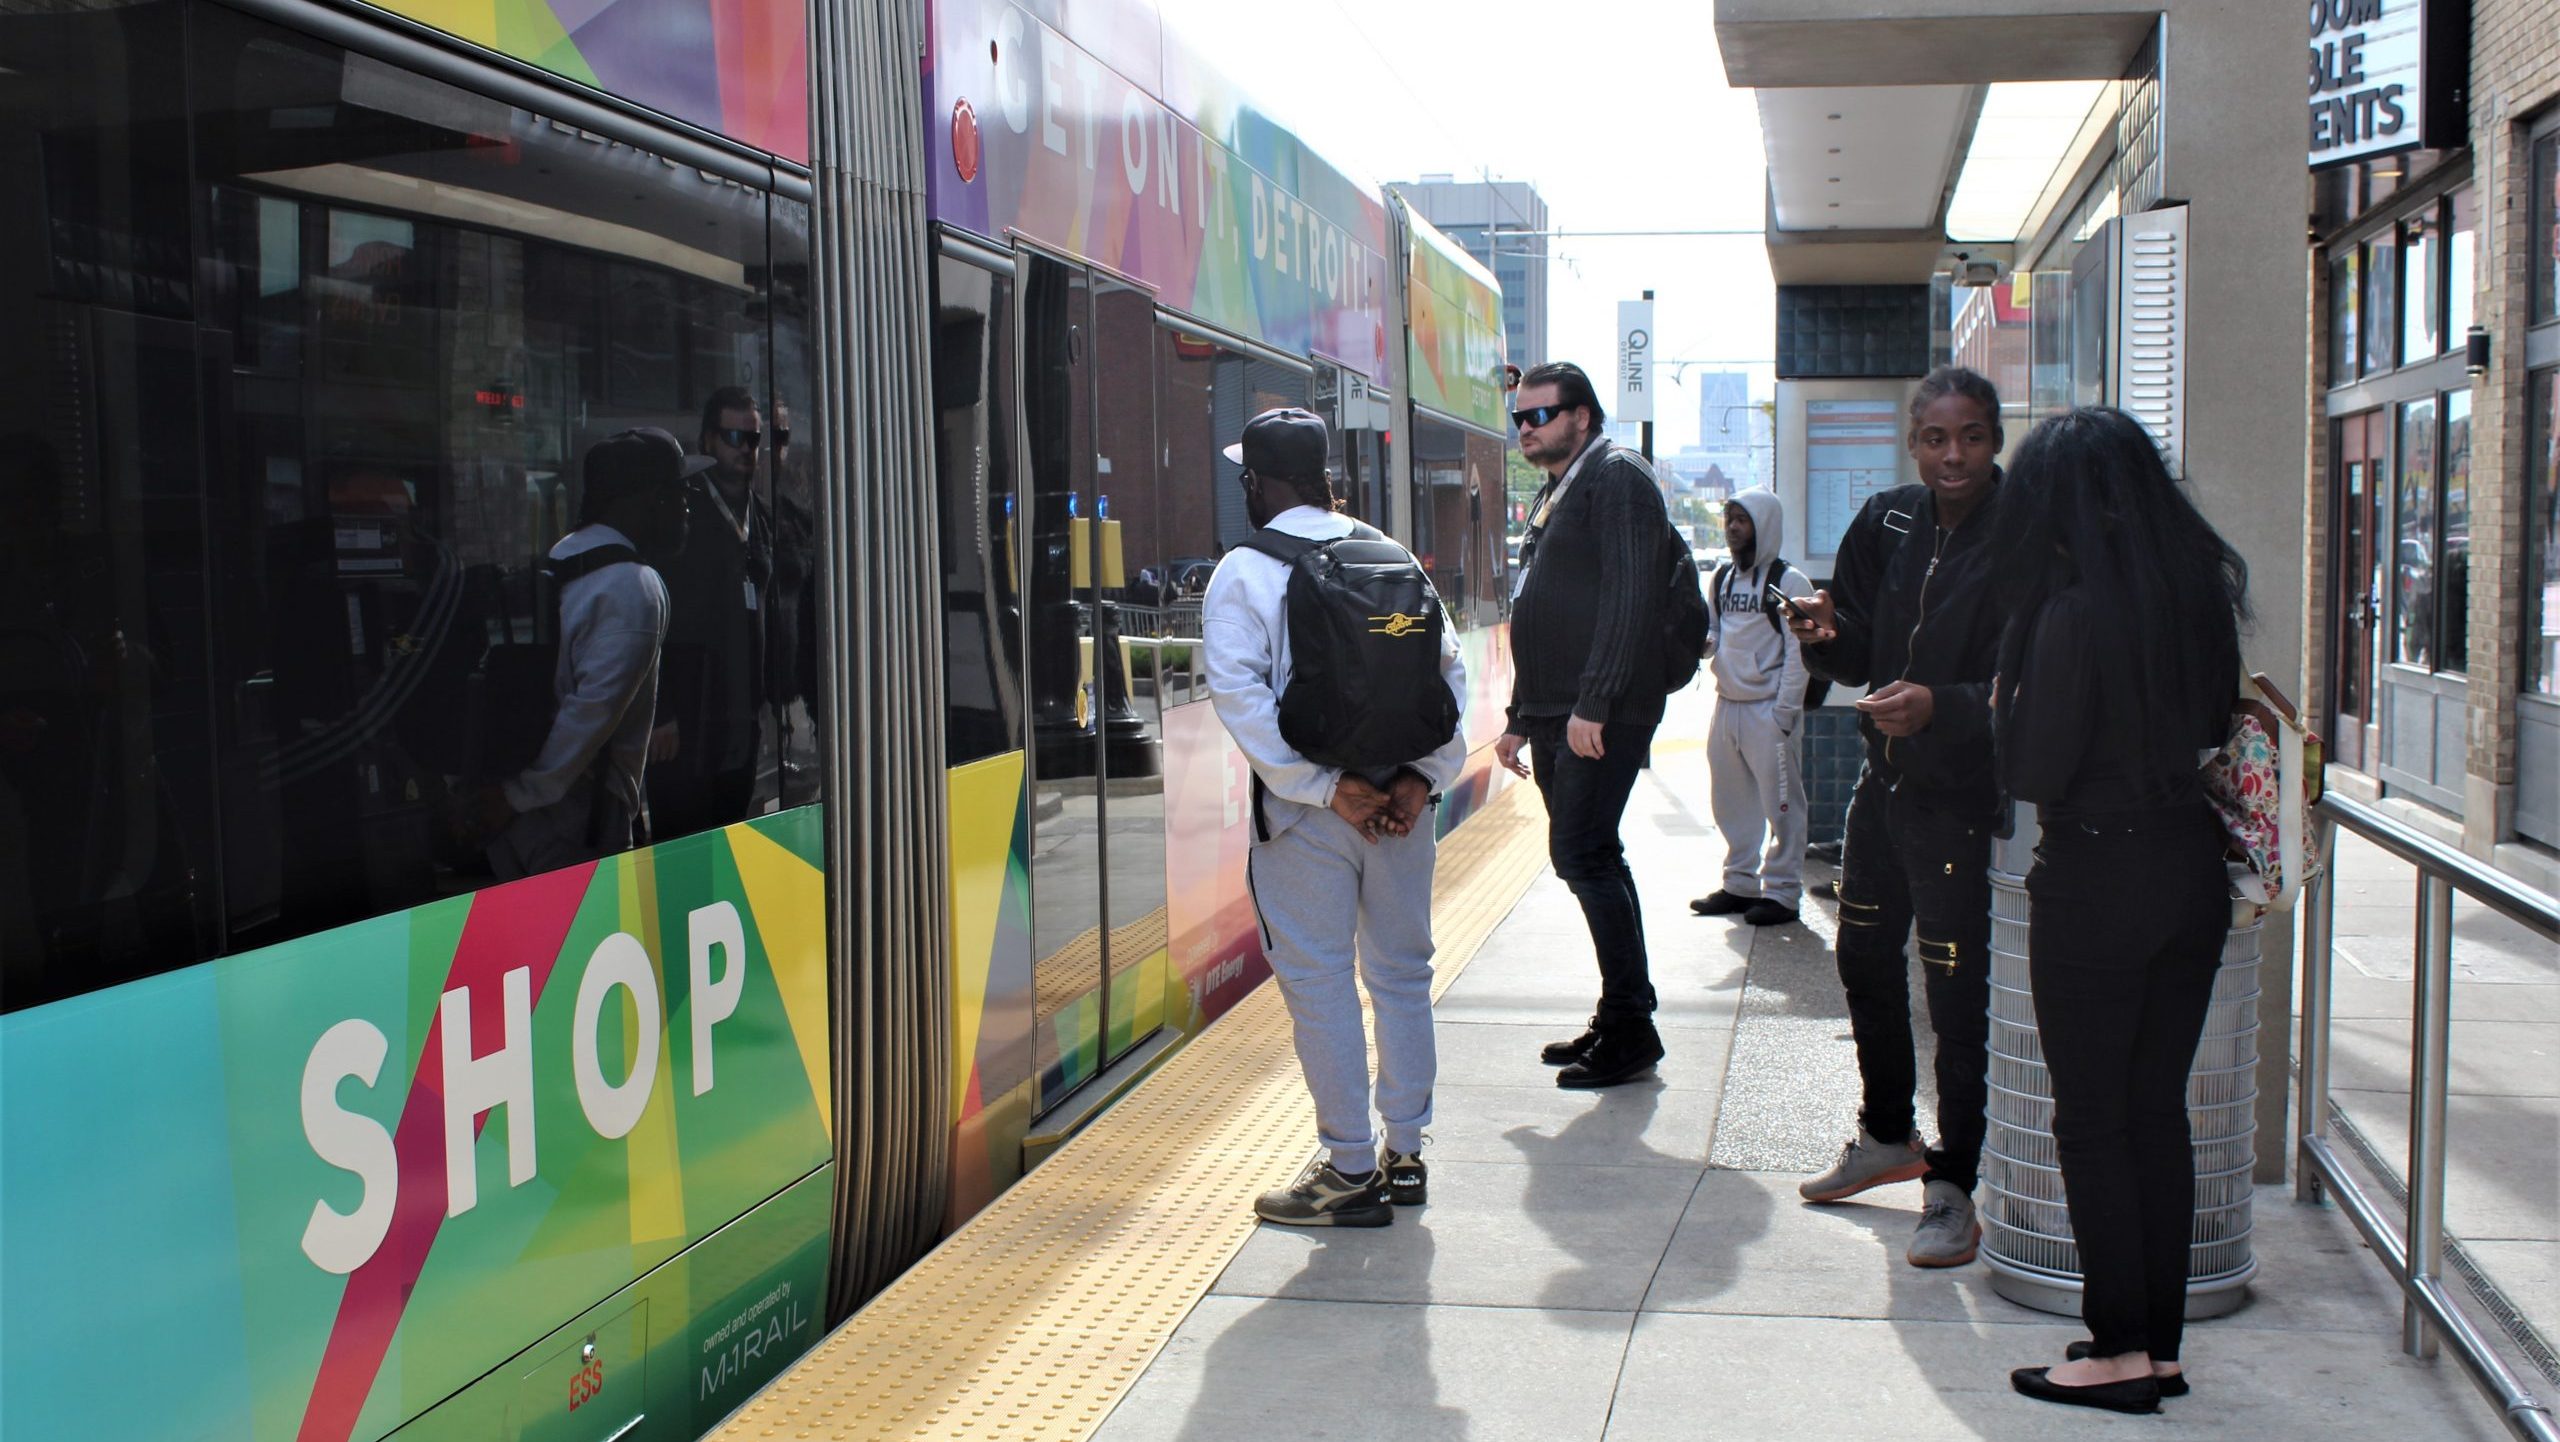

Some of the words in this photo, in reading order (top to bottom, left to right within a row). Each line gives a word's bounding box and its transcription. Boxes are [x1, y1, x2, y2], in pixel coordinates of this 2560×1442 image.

[996, 5, 1099, 170] GET
[1122, 88, 1179, 215] ON
[1252, 172, 1368, 318] DETROIT!
[1627, 329, 1649, 393] QLINE
[300, 900, 747, 1275] SHOP
[703, 1321, 731, 1354] owned
[731, 1308, 748, 1334] and
[747, 1284, 782, 1322] operated
[781, 1280, 792, 1299] by
[568, 1358, 603, 1413] ESS
